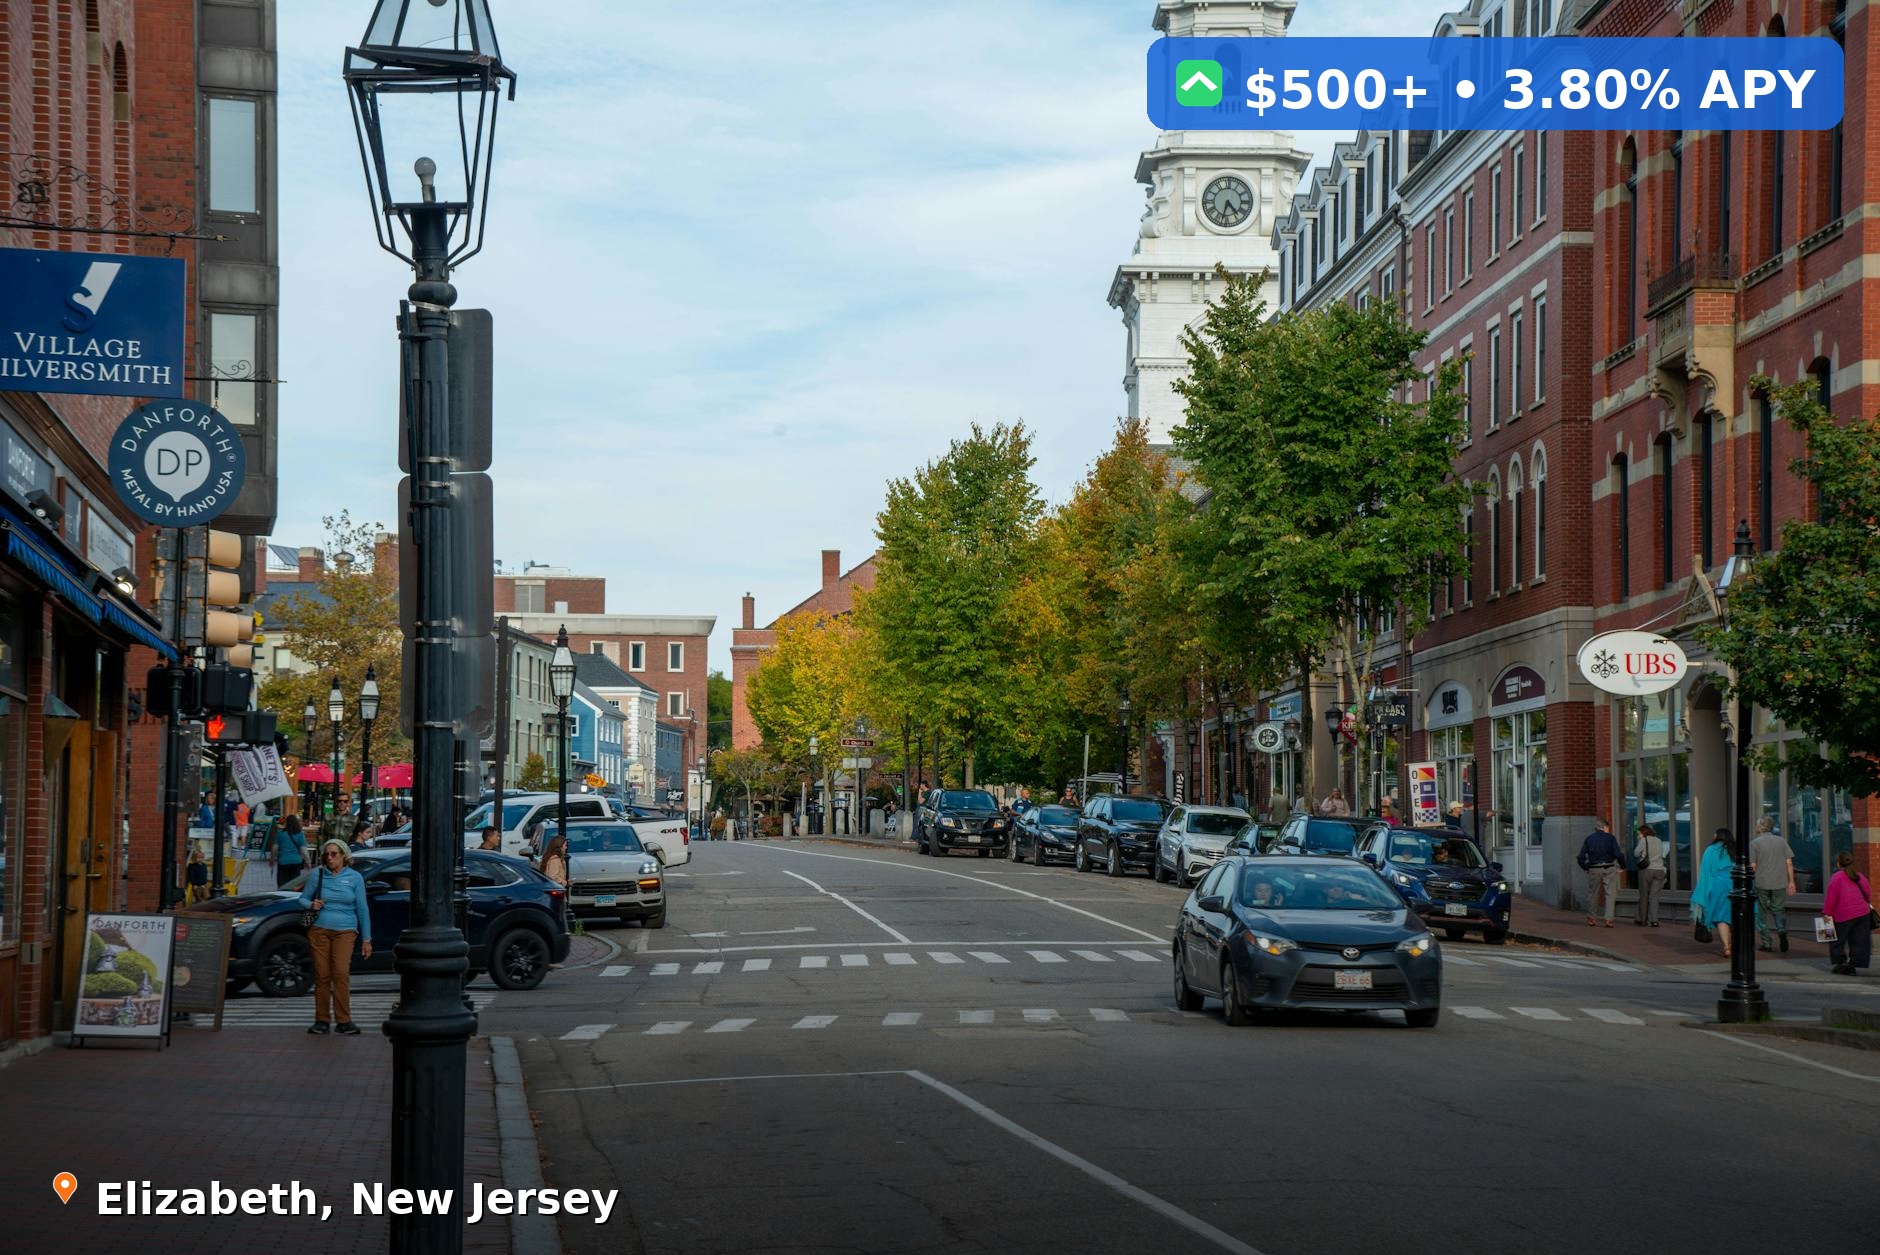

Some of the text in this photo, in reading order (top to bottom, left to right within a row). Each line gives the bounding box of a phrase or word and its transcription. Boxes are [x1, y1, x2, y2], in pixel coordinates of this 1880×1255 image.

[14, 332, 142, 359] VILLAGE
[0, 357, 172, 385] ILVERSMITH
[157, 449, 202, 477] DP
[121, 468, 234, 517] METAL BY HAND USA
[1624, 653, 1677, 675] UBS
[1412, 770, 1422, 822] OPEN
[96, 920, 166, 930] DANFORTH
